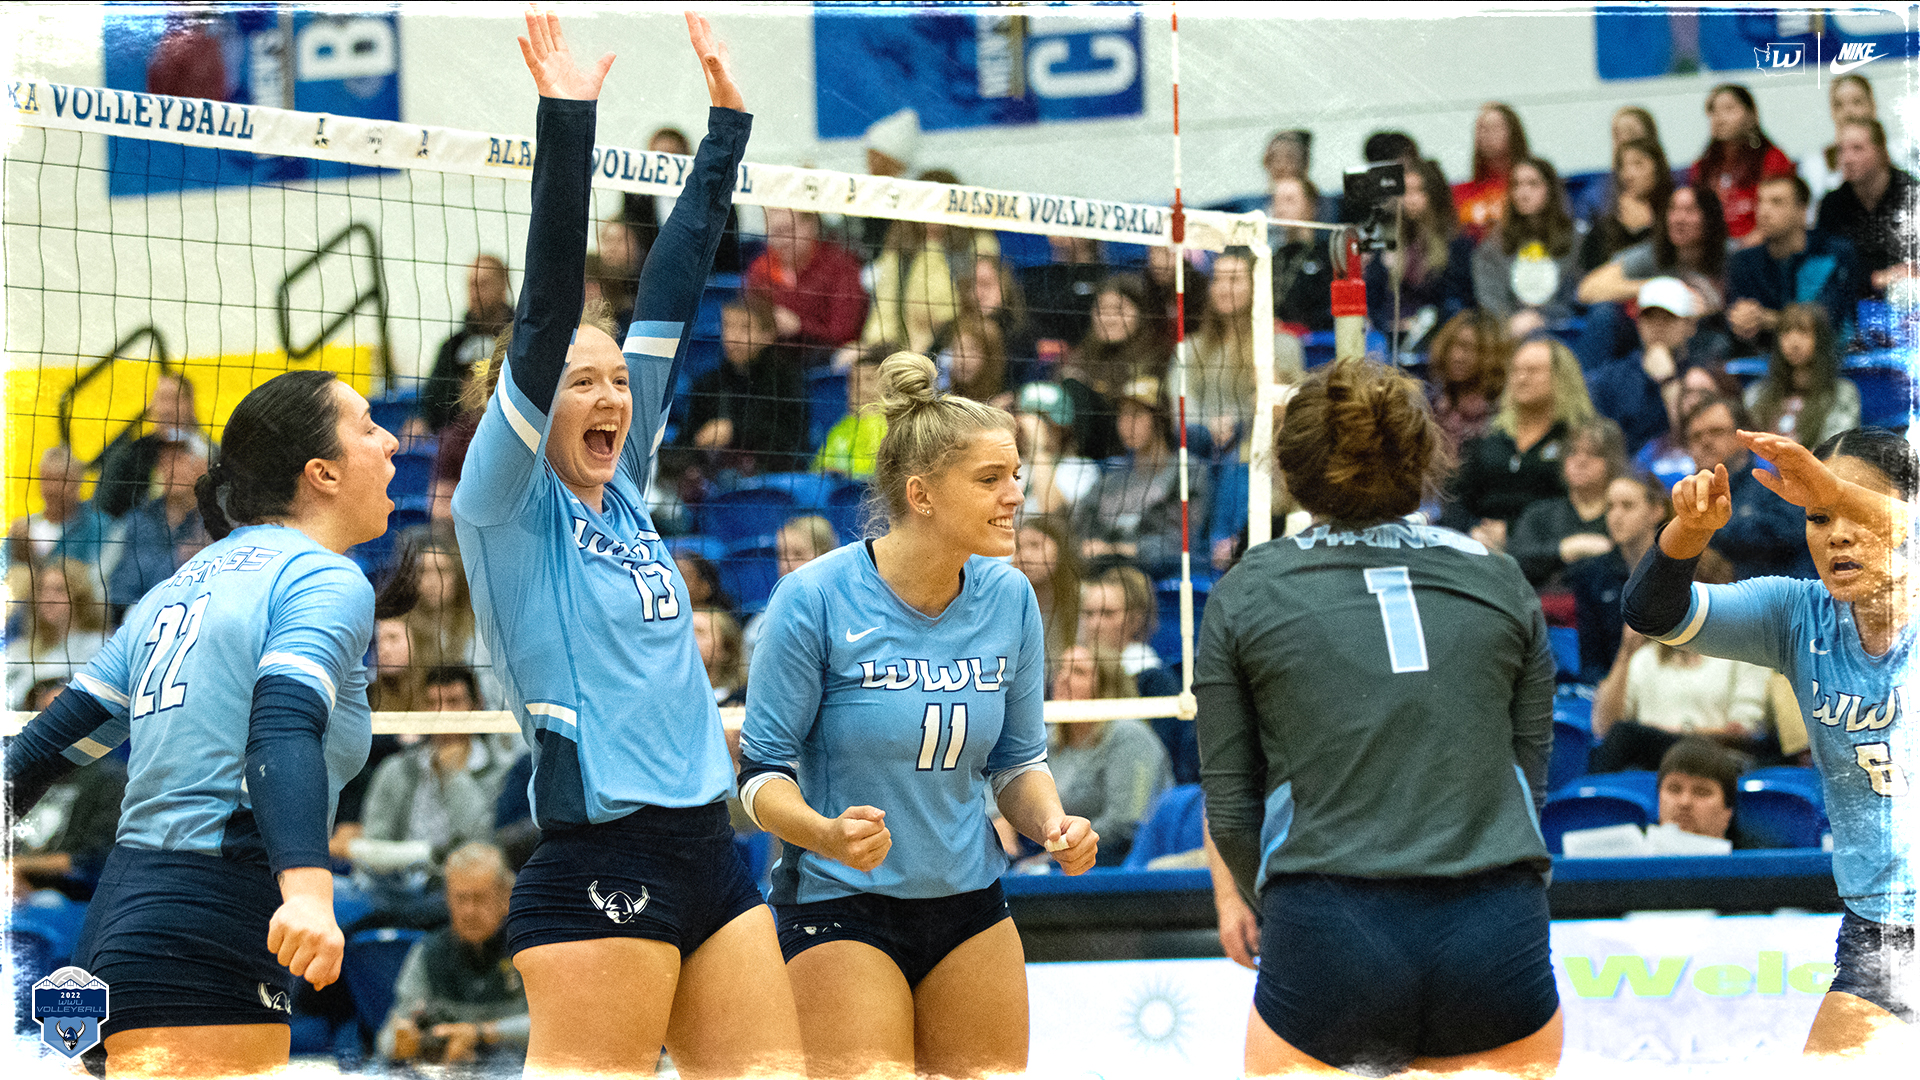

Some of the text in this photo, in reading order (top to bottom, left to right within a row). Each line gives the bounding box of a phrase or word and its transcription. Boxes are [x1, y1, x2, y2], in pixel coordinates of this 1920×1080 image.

[49, 84, 254, 139] VOLLEYBALL
[488, 137, 534, 168] ALA
[947, 188, 1164, 235] ALASKA VOLLEYBALL
[622, 560, 680, 622] 13
[1363, 566, 1429, 674] 1
[133, 591, 211, 721] 22
[857, 656, 1008, 692] WWU
[915, 703, 968, 771] 11
[1853, 741, 1910, 797] 6
